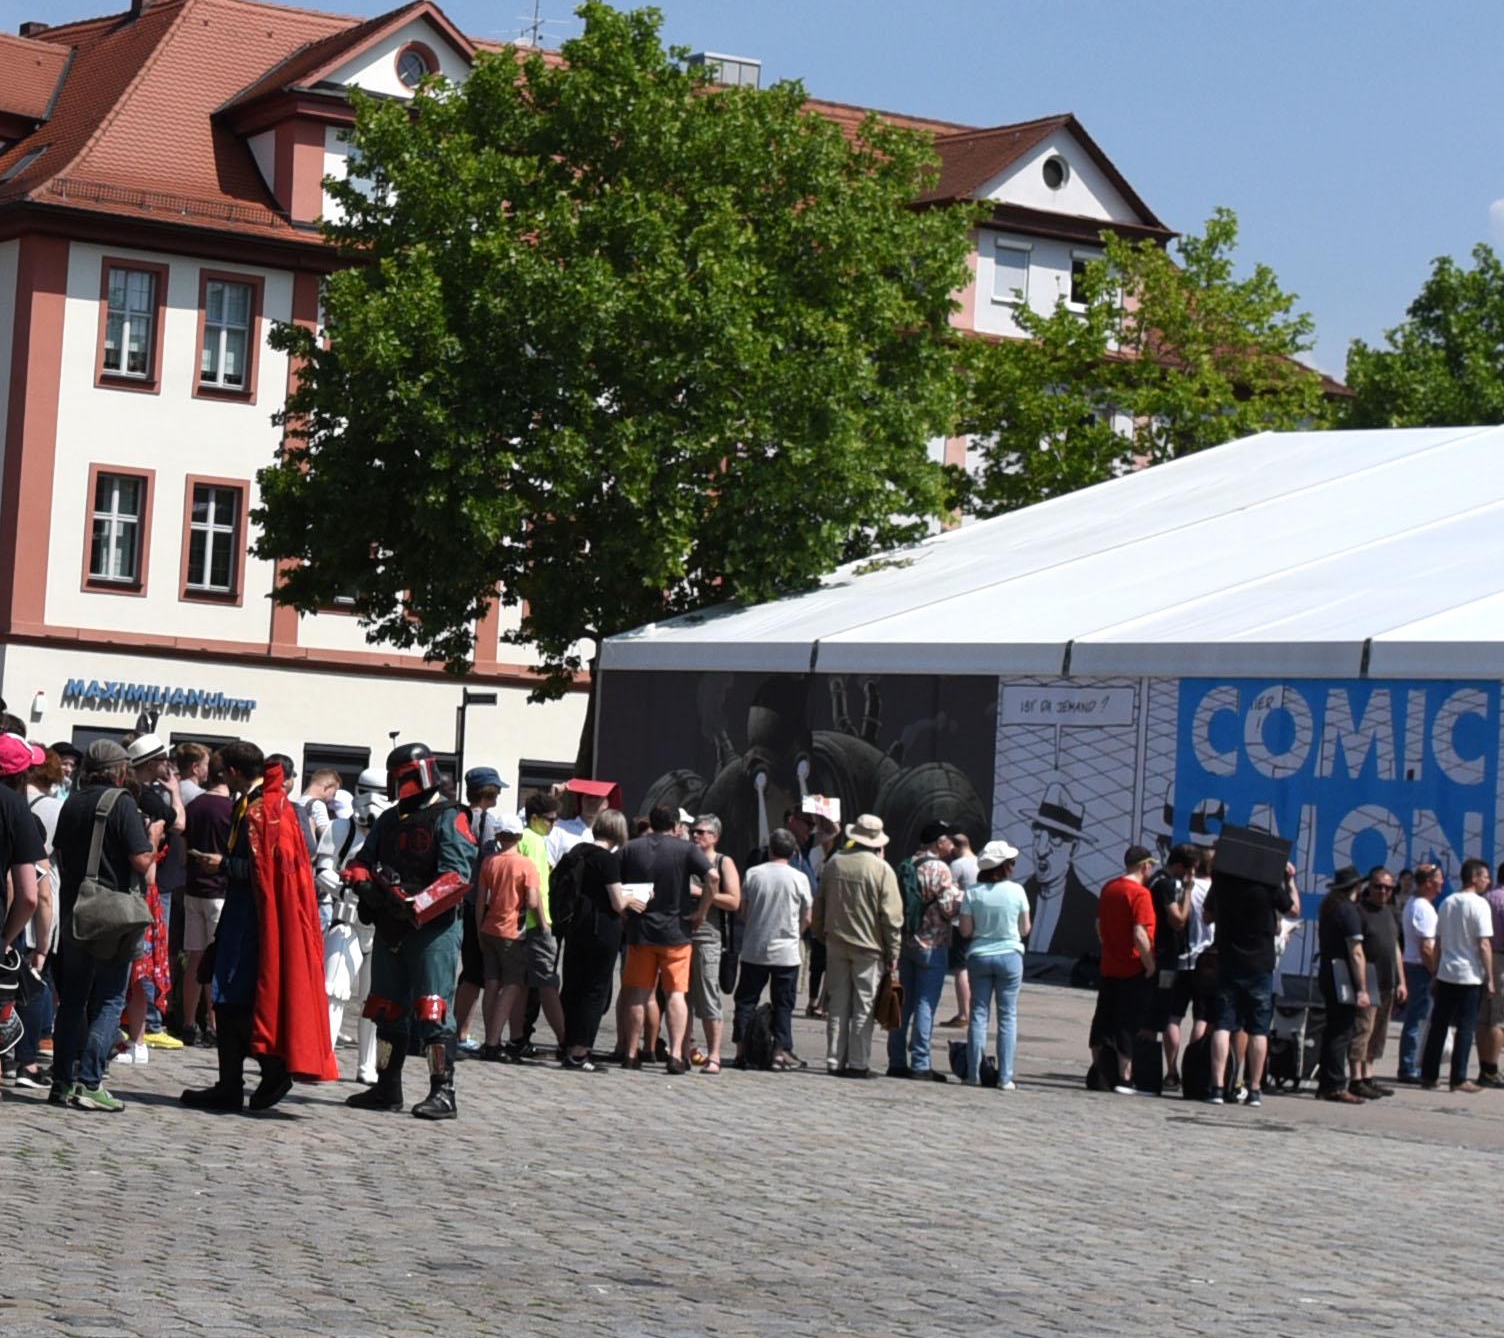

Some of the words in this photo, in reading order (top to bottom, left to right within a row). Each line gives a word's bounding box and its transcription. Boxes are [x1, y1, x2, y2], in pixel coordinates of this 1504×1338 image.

[1020, 699, 1037, 714] IST
[1056, 698, 1097, 714] JEMAND
[1192, 685, 1488, 785] COMIC
